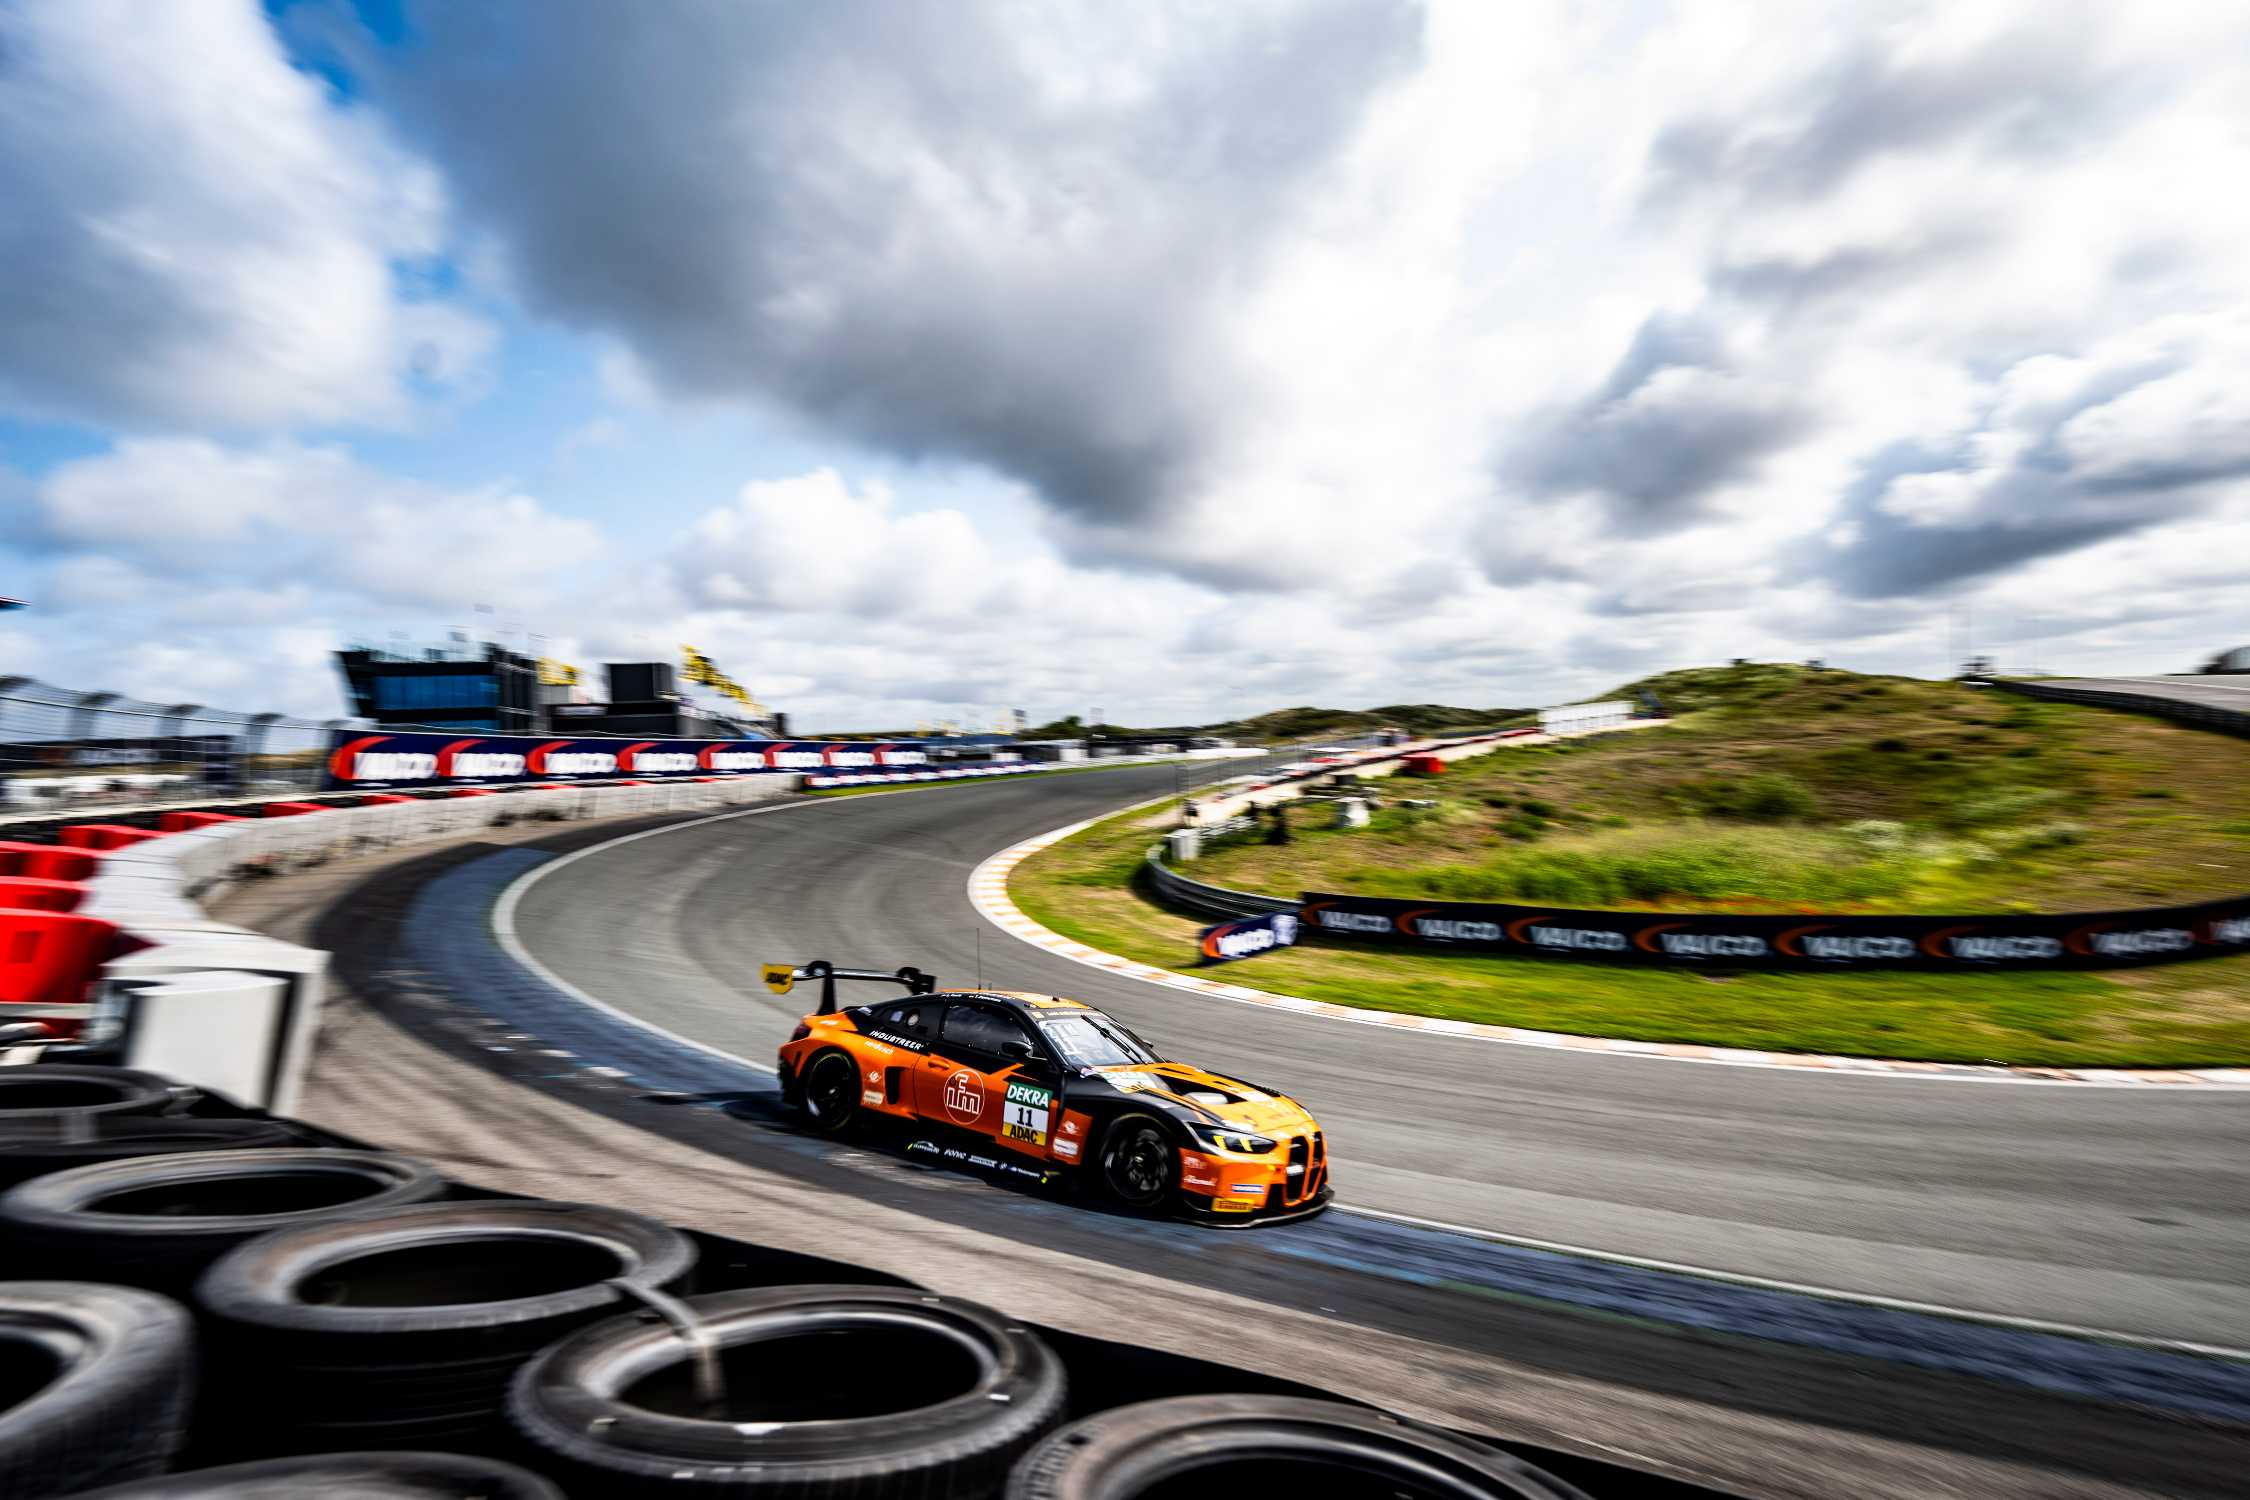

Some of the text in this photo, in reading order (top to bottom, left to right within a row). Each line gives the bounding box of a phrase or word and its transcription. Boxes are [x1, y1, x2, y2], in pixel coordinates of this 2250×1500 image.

[869, 1030, 922, 1050] INDUSTREER
[947, 1073, 981, 1114] ifm
[1006, 1084, 1049, 1108] DEKRA
[1016, 1107, 1033, 1128] 11
[1009, 1125, 1039, 1143] ADAC
